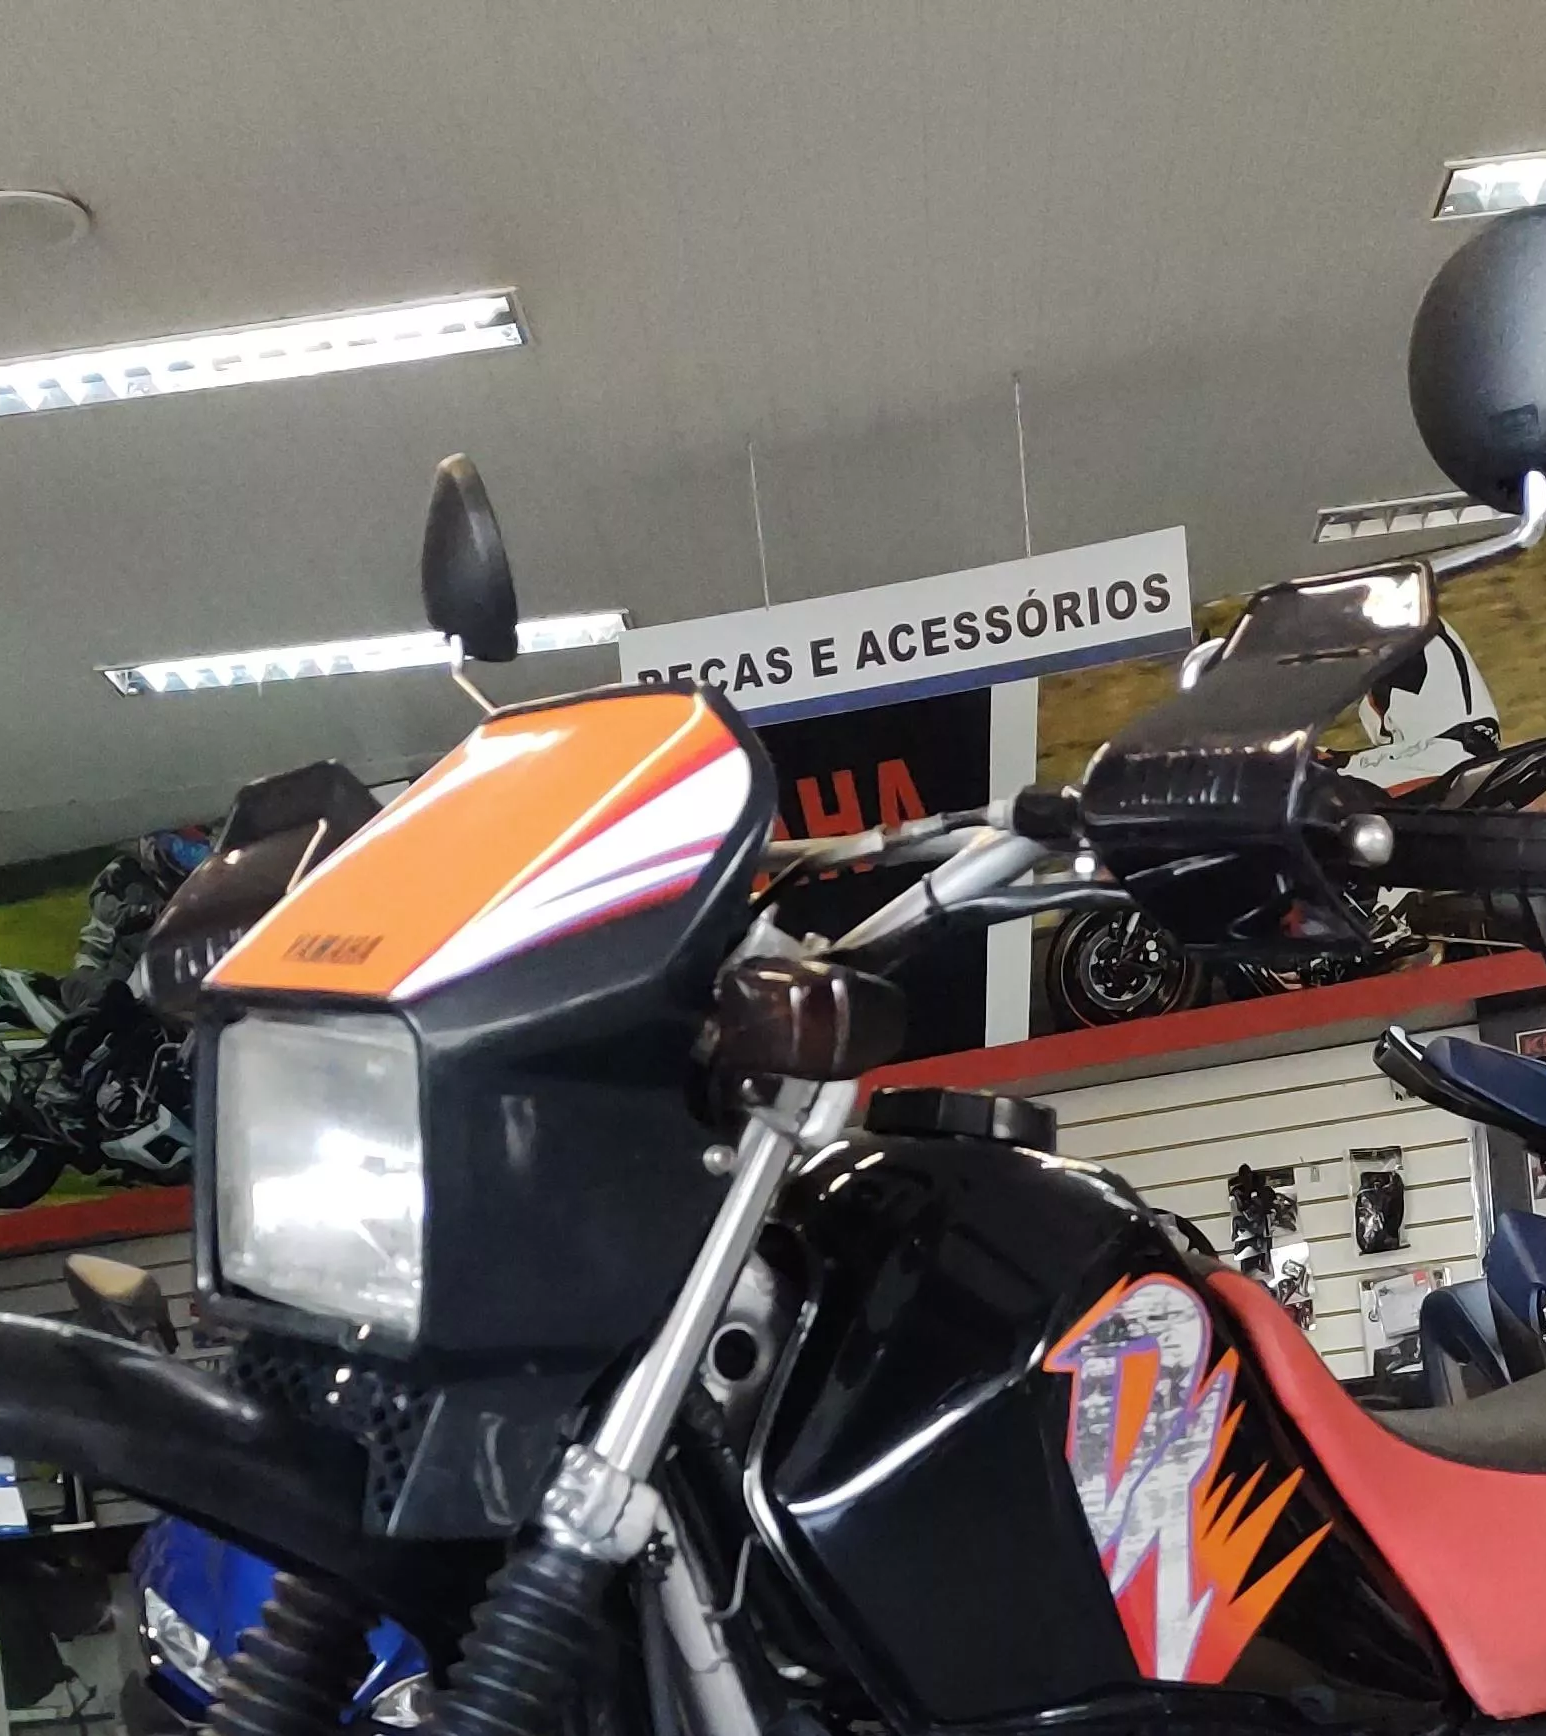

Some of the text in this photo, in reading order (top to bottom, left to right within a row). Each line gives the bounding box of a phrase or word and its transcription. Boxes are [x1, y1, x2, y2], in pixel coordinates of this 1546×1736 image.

[810, 638, 839, 677] E
[856, 573, 1171, 671] ACESSÓRIOS
[280, 932, 385, 965] YAMAHA
